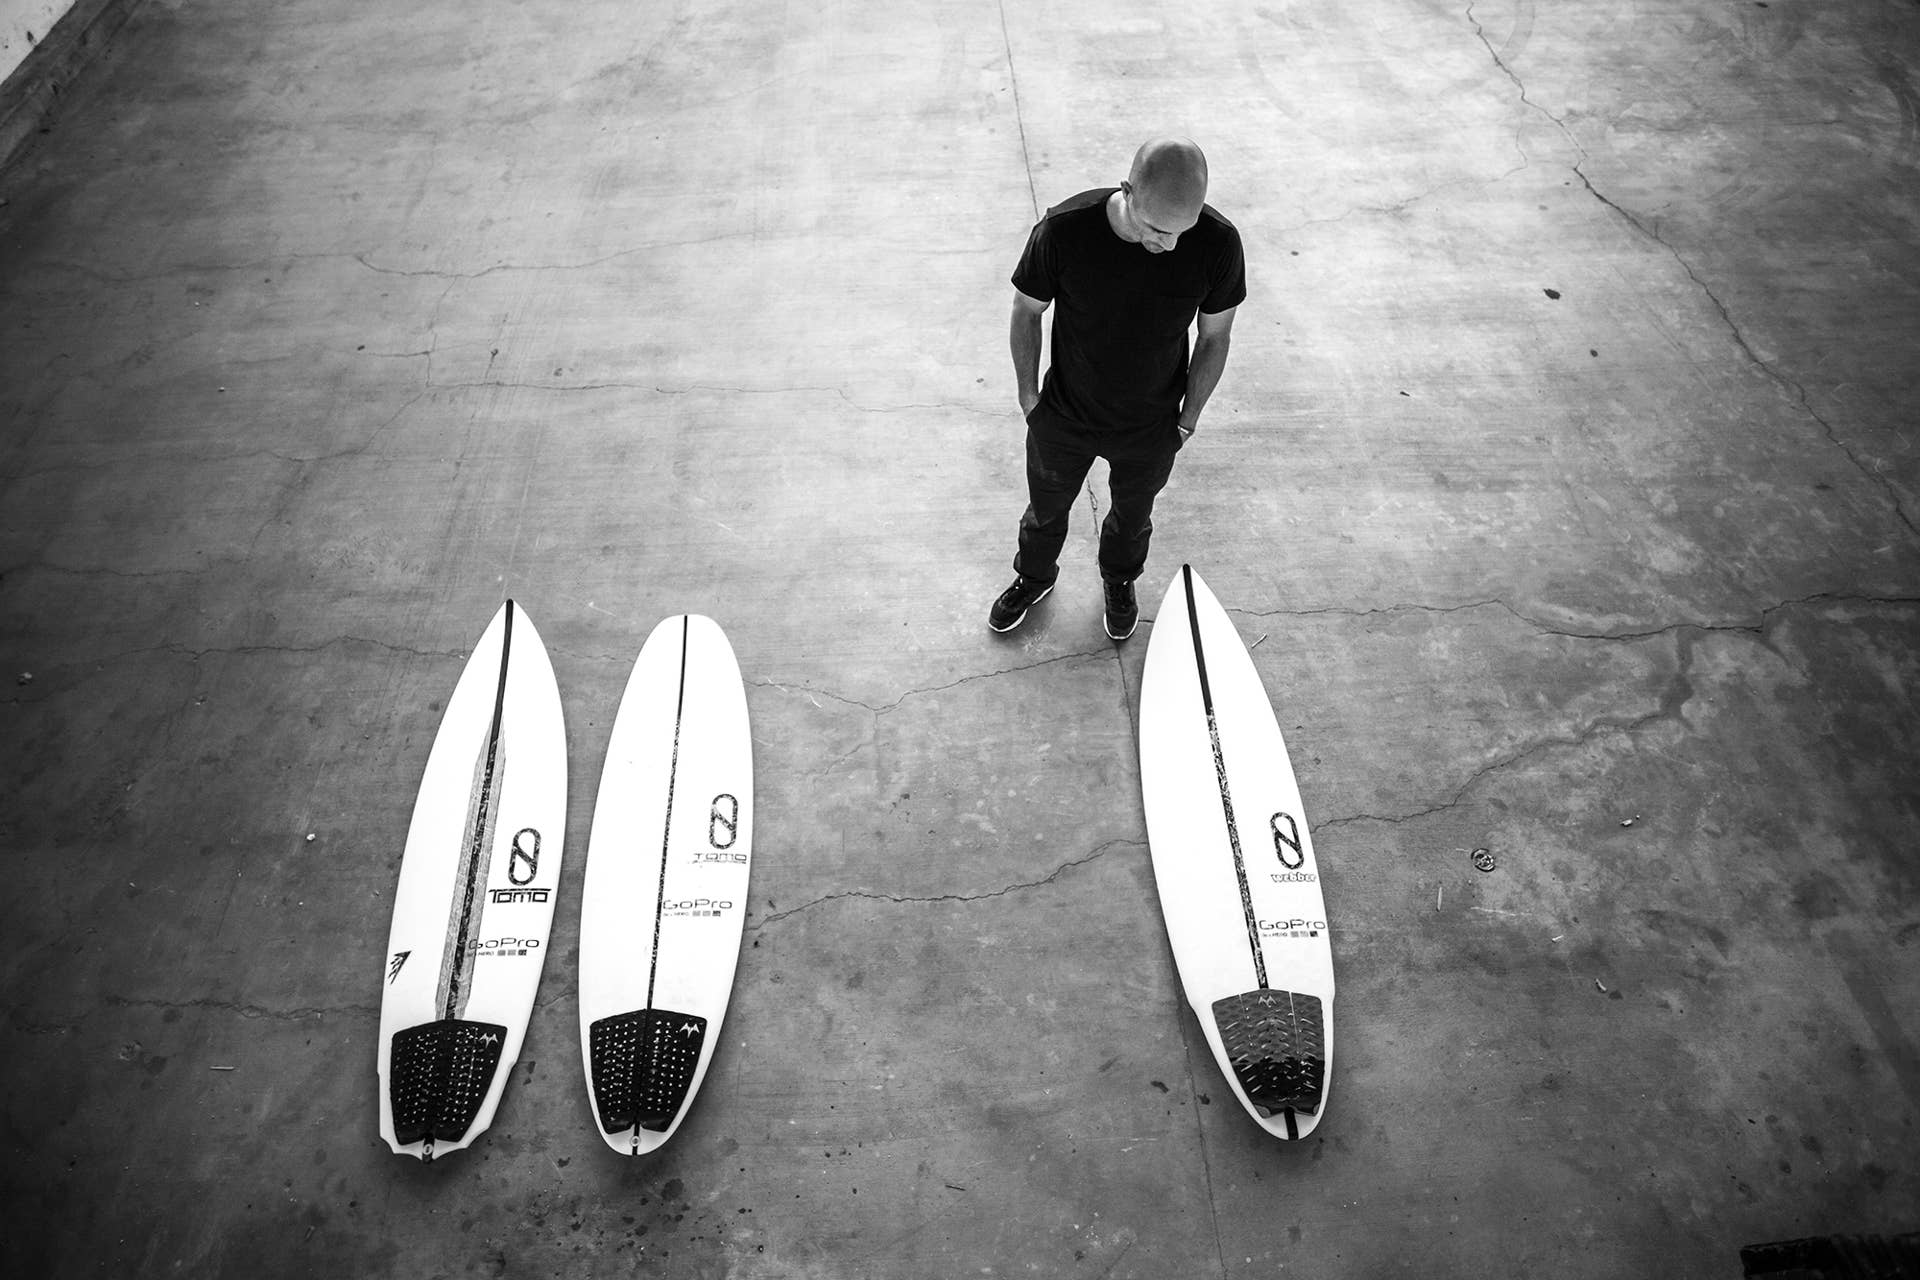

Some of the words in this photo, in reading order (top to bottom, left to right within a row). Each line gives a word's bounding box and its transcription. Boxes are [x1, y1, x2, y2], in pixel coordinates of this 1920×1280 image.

[663, 899, 732, 910] GoPro
[1259, 919, 1326, 930] GoPro
[469, 938, 540, 950] GoPro
